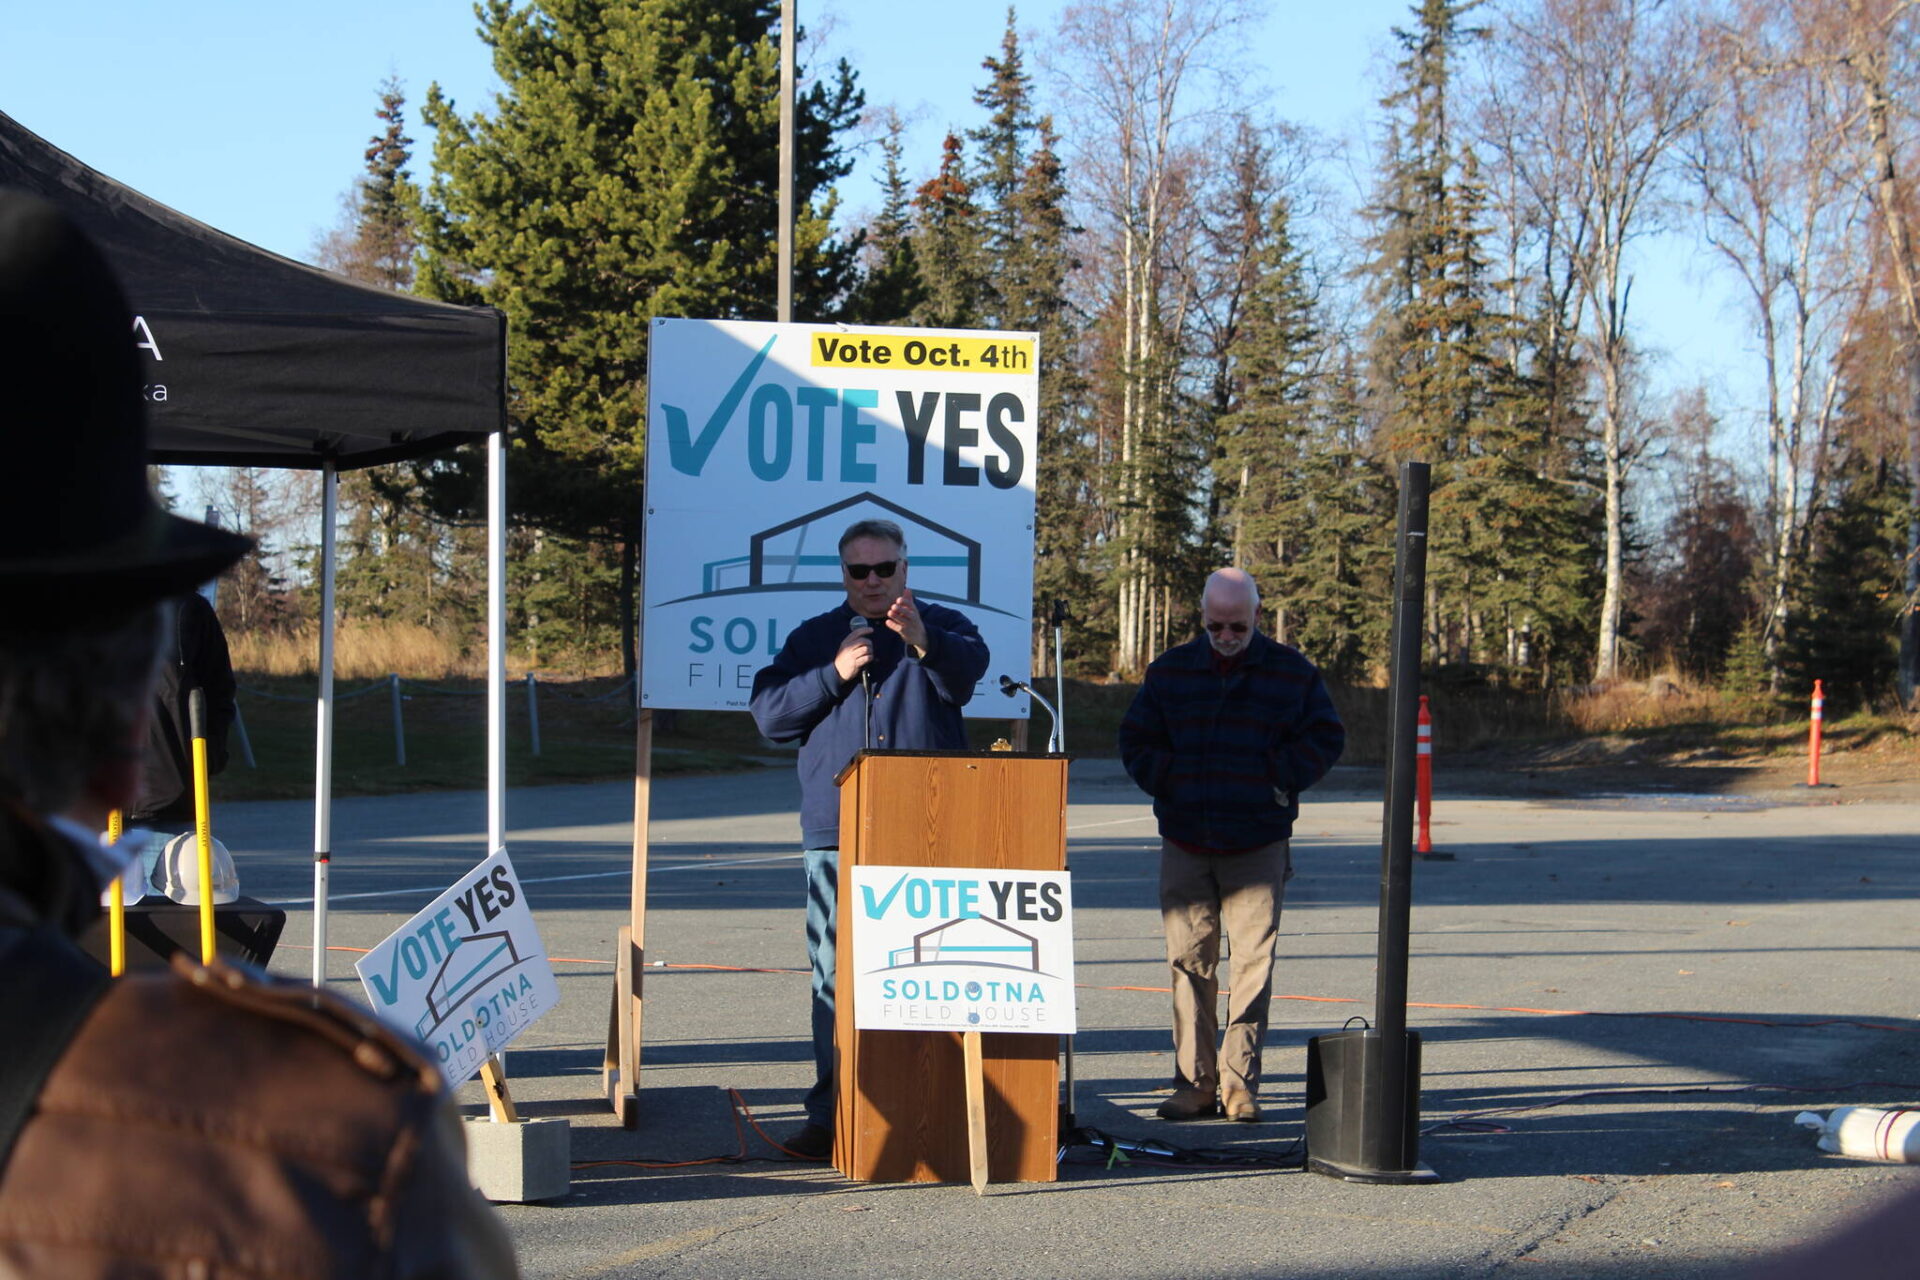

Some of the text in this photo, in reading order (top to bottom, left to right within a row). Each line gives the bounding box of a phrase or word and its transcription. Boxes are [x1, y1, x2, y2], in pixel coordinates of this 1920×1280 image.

[817, 338, 1028, 369] Vote Oct. 4th
[661, 334, 1025, 490] VOTE YES
[689, 663, 752, 689] FIE
[860, 873, 1063, 922] VOTE YES
[369, 864, 516, 1006] VOTE YES
[883, 979, 1045, 1003] SOLDOTNA
[883, 1004, 952, 1020] FIELD
[436, 973, 533, 1063] OLDOTNA
[447, 1046, 477, 1079] ELD
[484, 993, 538, 1047] HOUSE
